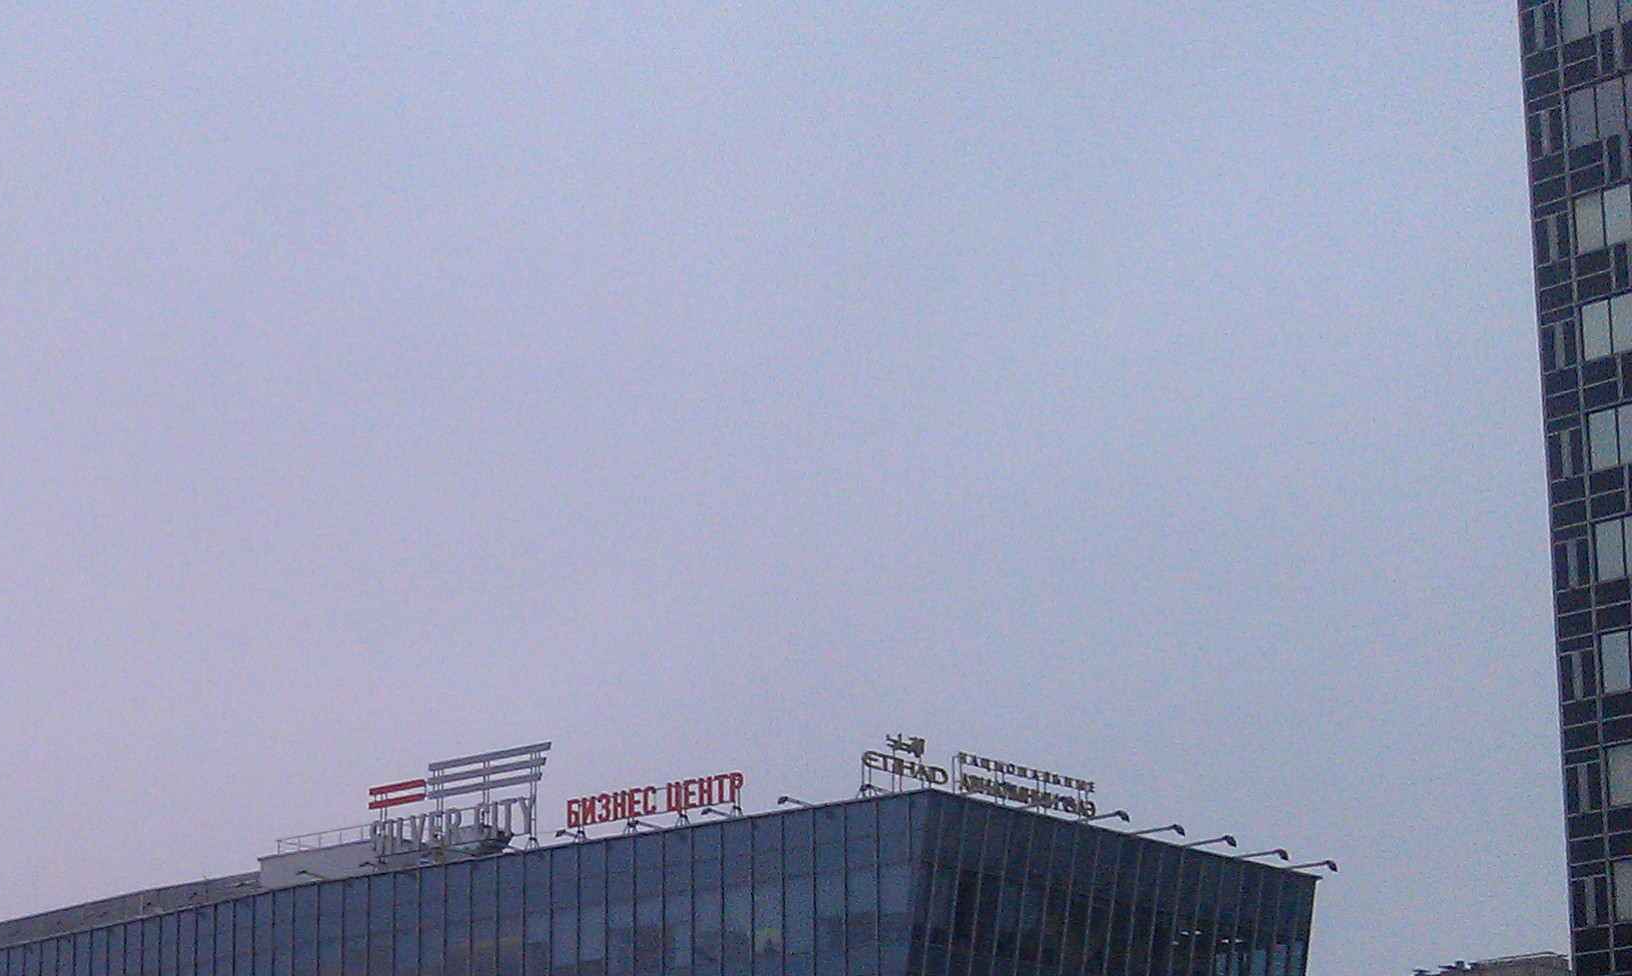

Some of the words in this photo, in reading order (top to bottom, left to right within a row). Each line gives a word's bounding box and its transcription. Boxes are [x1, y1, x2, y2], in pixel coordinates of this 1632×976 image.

[862, 751, 949, 785] ETIHAD
[370, 808, 463, 854] SILVER
[473, 796, 537, 841] CITY
[567, 786, 657, 828] БИЗНЕС
[665, 771, 744, 812] ЦЕНТР
